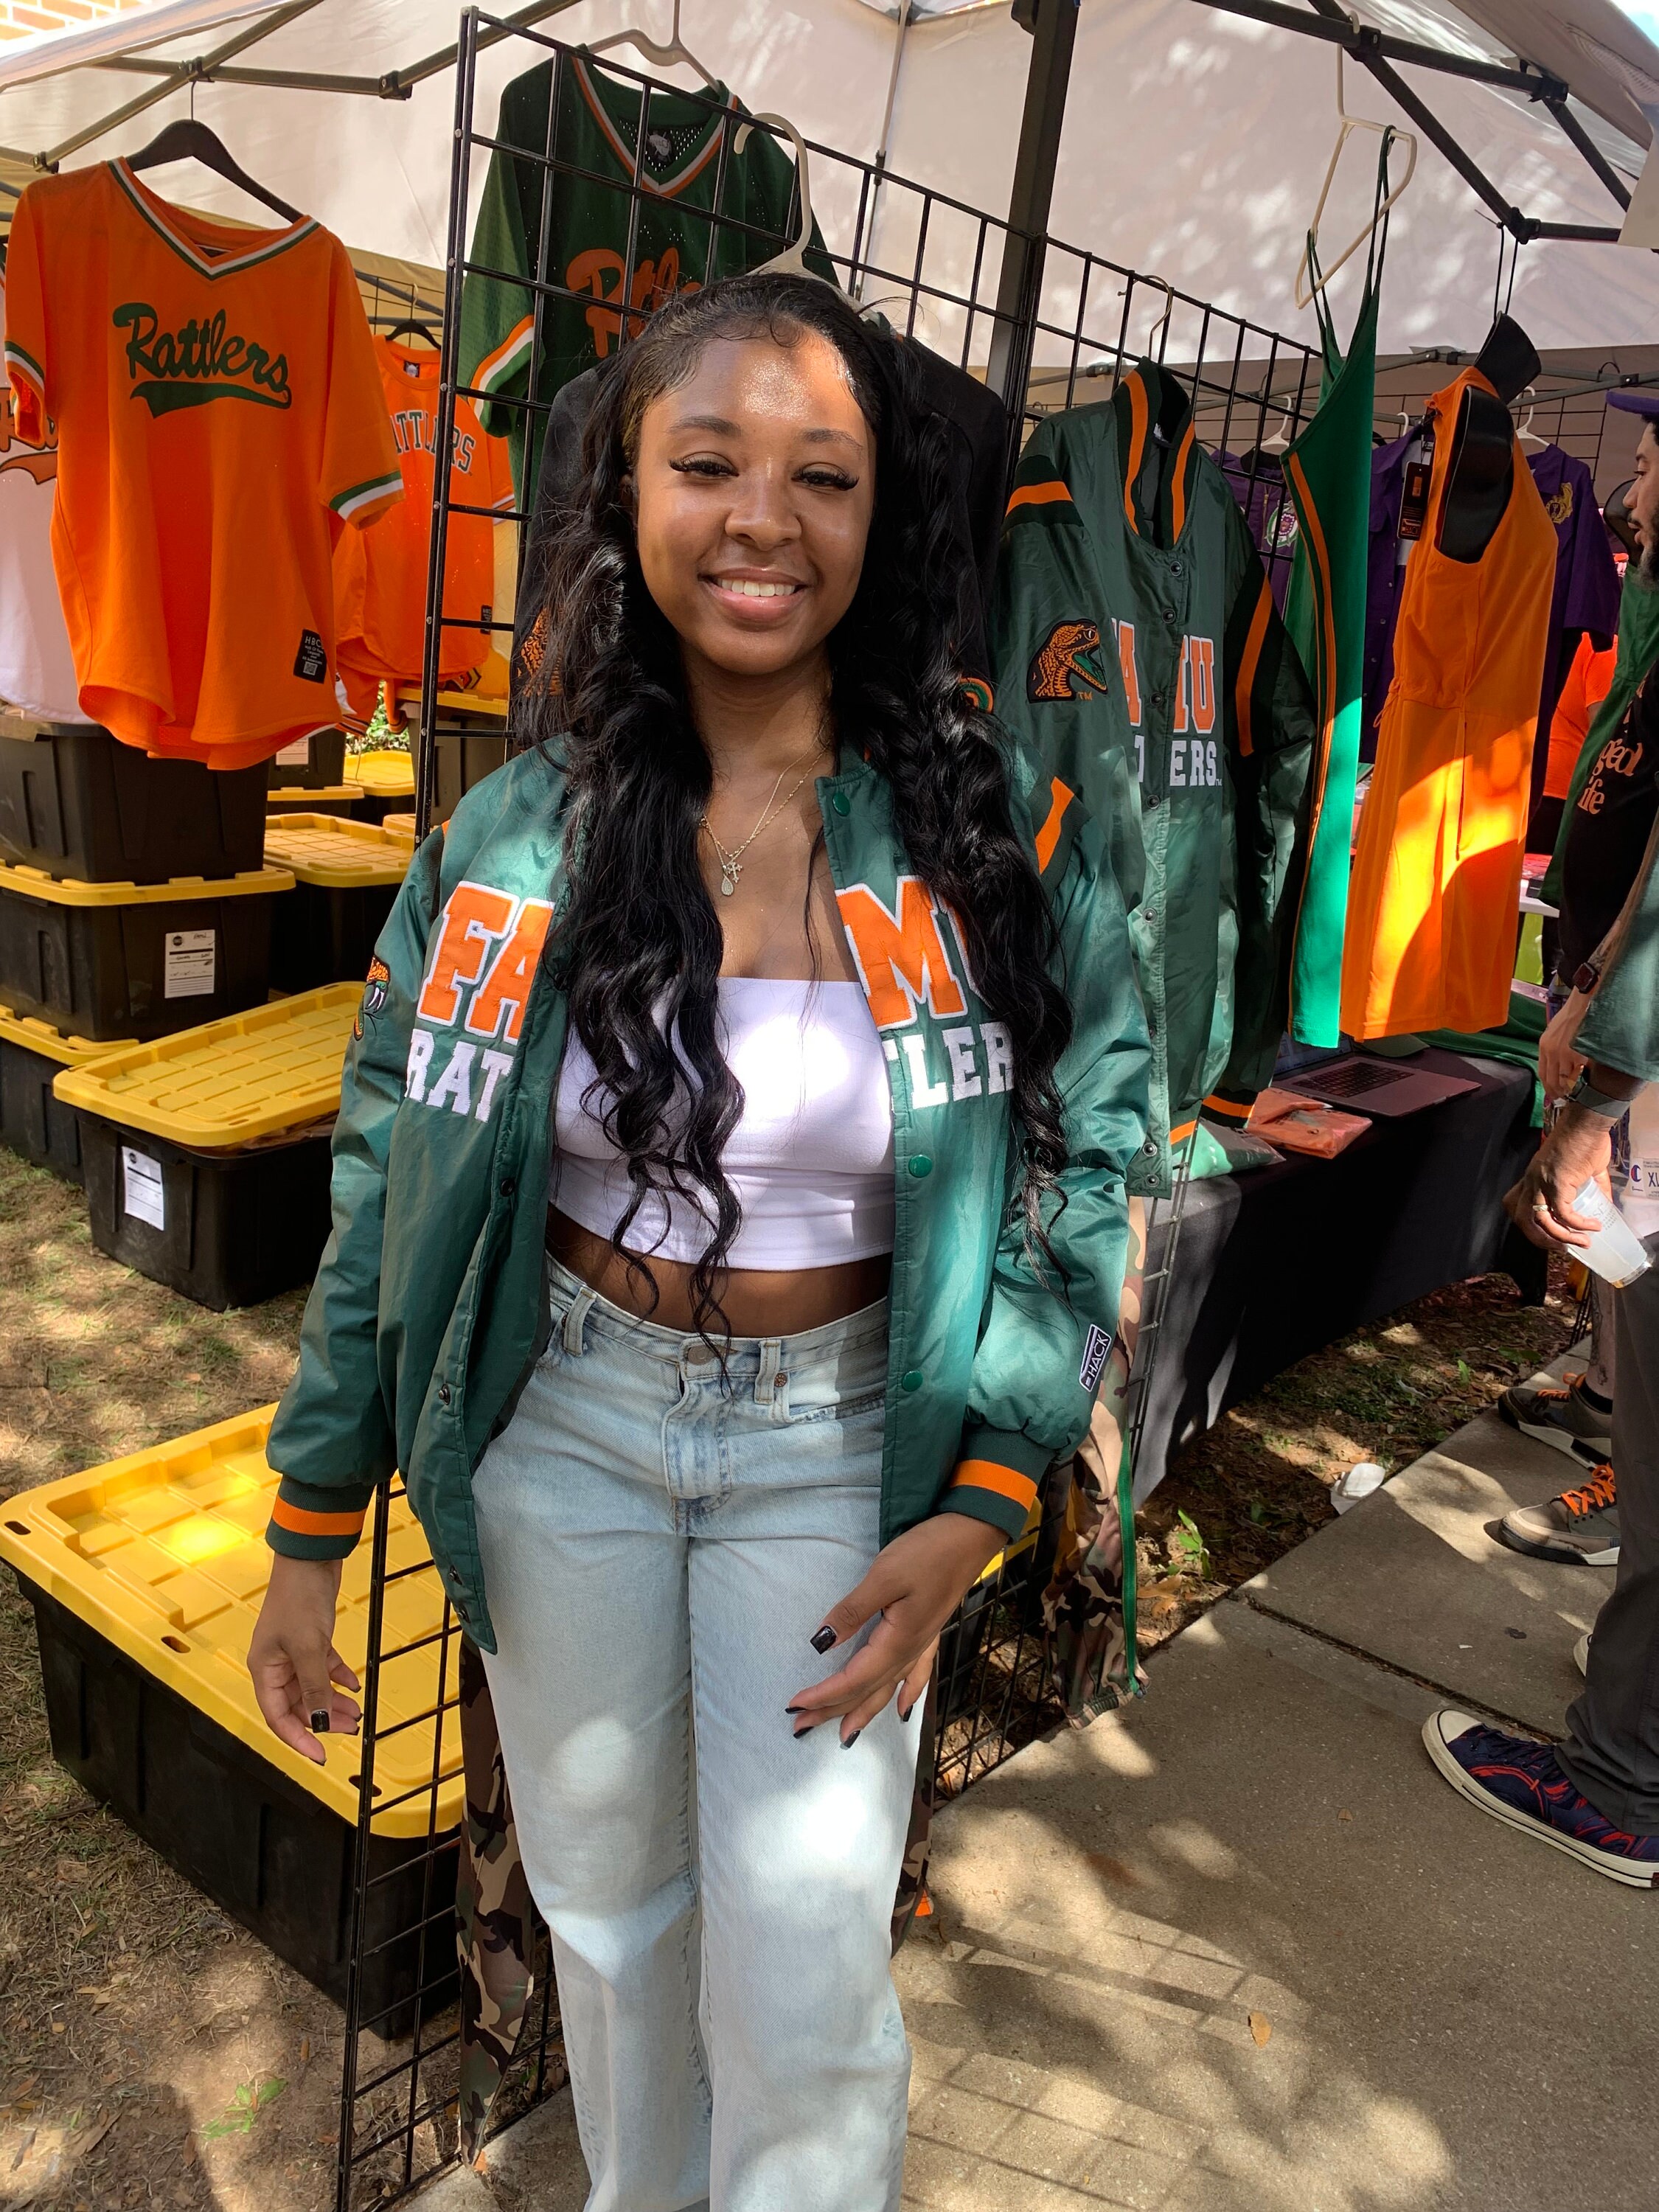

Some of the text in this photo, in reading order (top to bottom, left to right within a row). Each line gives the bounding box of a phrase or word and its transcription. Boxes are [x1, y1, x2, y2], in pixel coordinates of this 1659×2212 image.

[113, 302, 289, 392] Rattlers
[304, 636, 323, 648] HBC
[835, 874, 992, 1032] M
[882, 1021, 1015, 1110] LER
[1088, 1333, 1109, 1378] HACK
